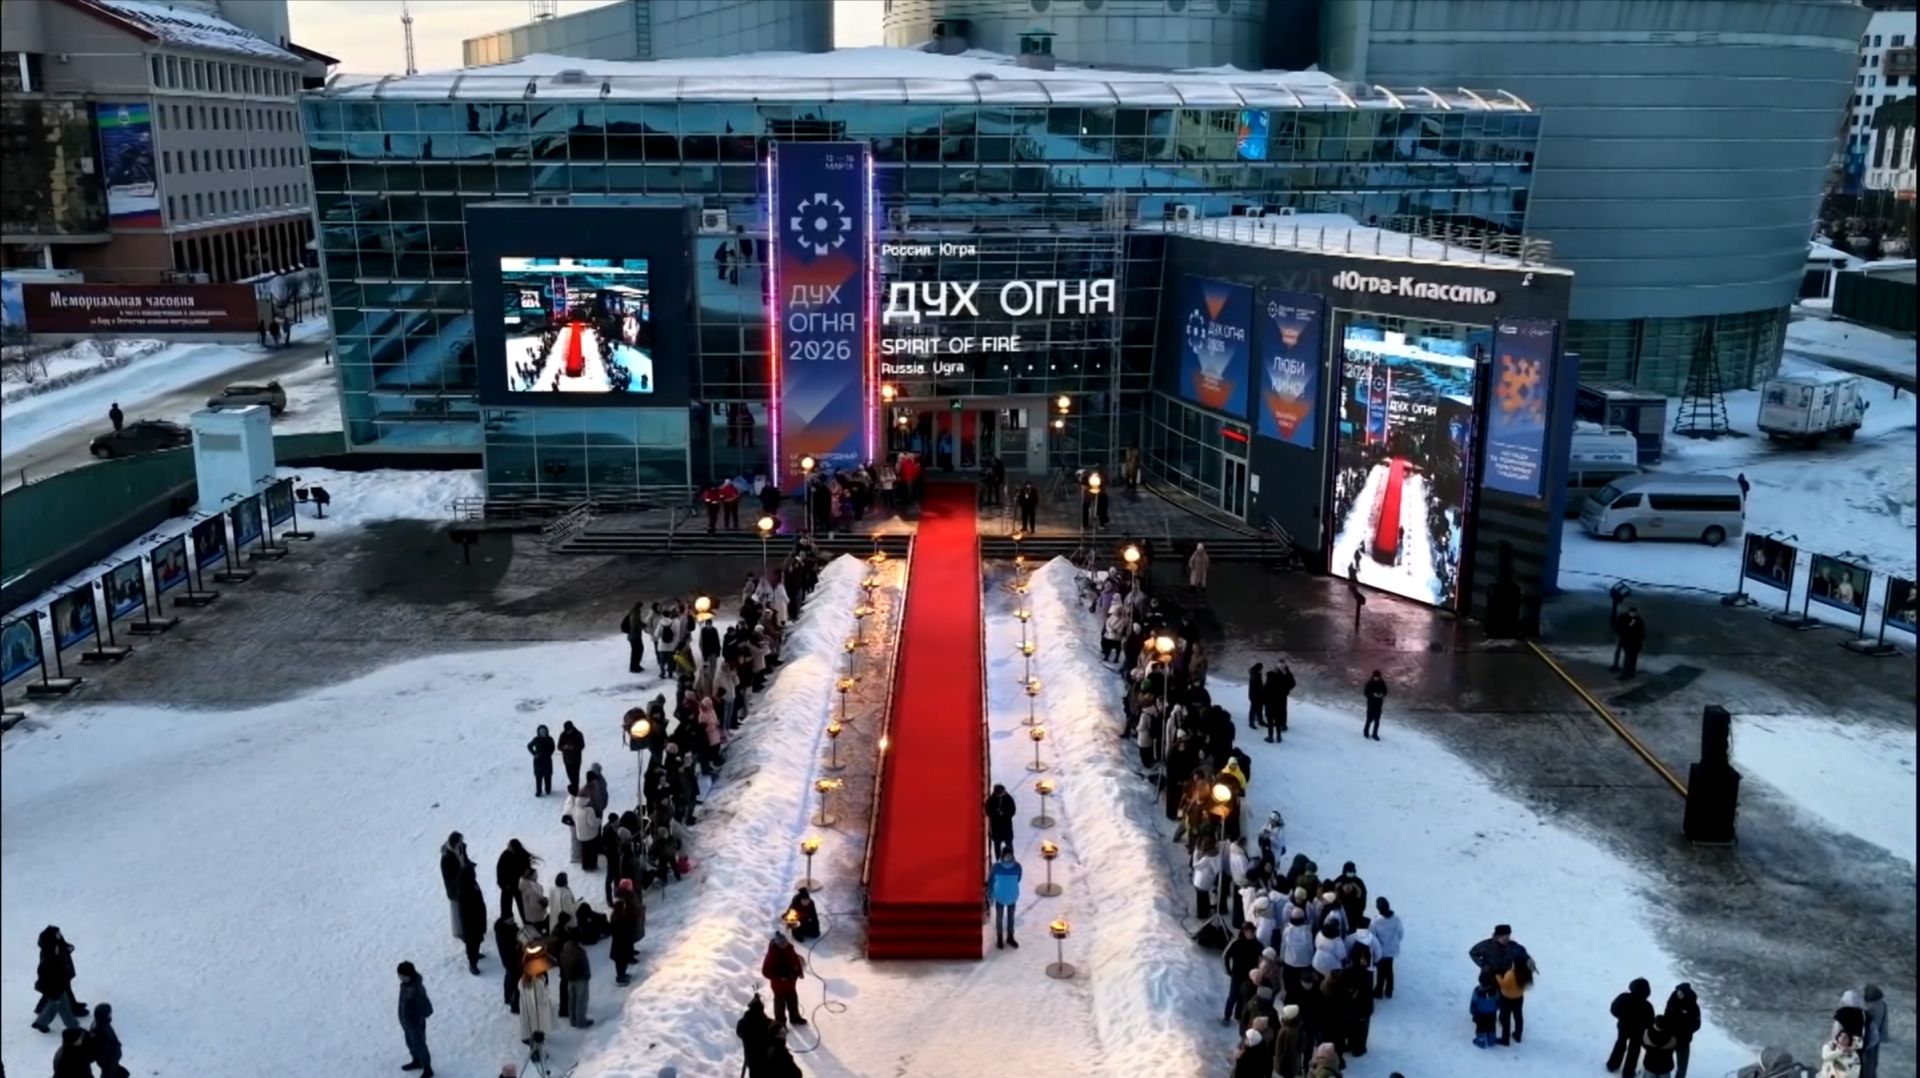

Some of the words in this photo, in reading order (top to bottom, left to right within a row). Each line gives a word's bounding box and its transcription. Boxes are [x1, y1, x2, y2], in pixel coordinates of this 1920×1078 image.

[939, 242, 977, 259] Югра
[789, 284, 842, 309] ДУХ
[1332, 270, 1497, 305] «Югра-Классик»
[50, 290, 142, 312] Мемориальная
[146, 295, 195, 307] часовня
[882, 280, 981, 325] ДУХ
[999, 278, 1116, 316] ОГНЯ
[788, 312, 855, 333] ОГНЯ
[789, 340, 852, 361] 2026
[881, 337, 941, 355] SPIRIT
[948, 336, 976, 354] OF
[982, 335, 1022, 353] FIRE
[932, 360, 965, 376] Ugra
[1272, 356, 1306, 377] ЛЮБИ
[1411, 402, 1438, 417] ОГНЯ
